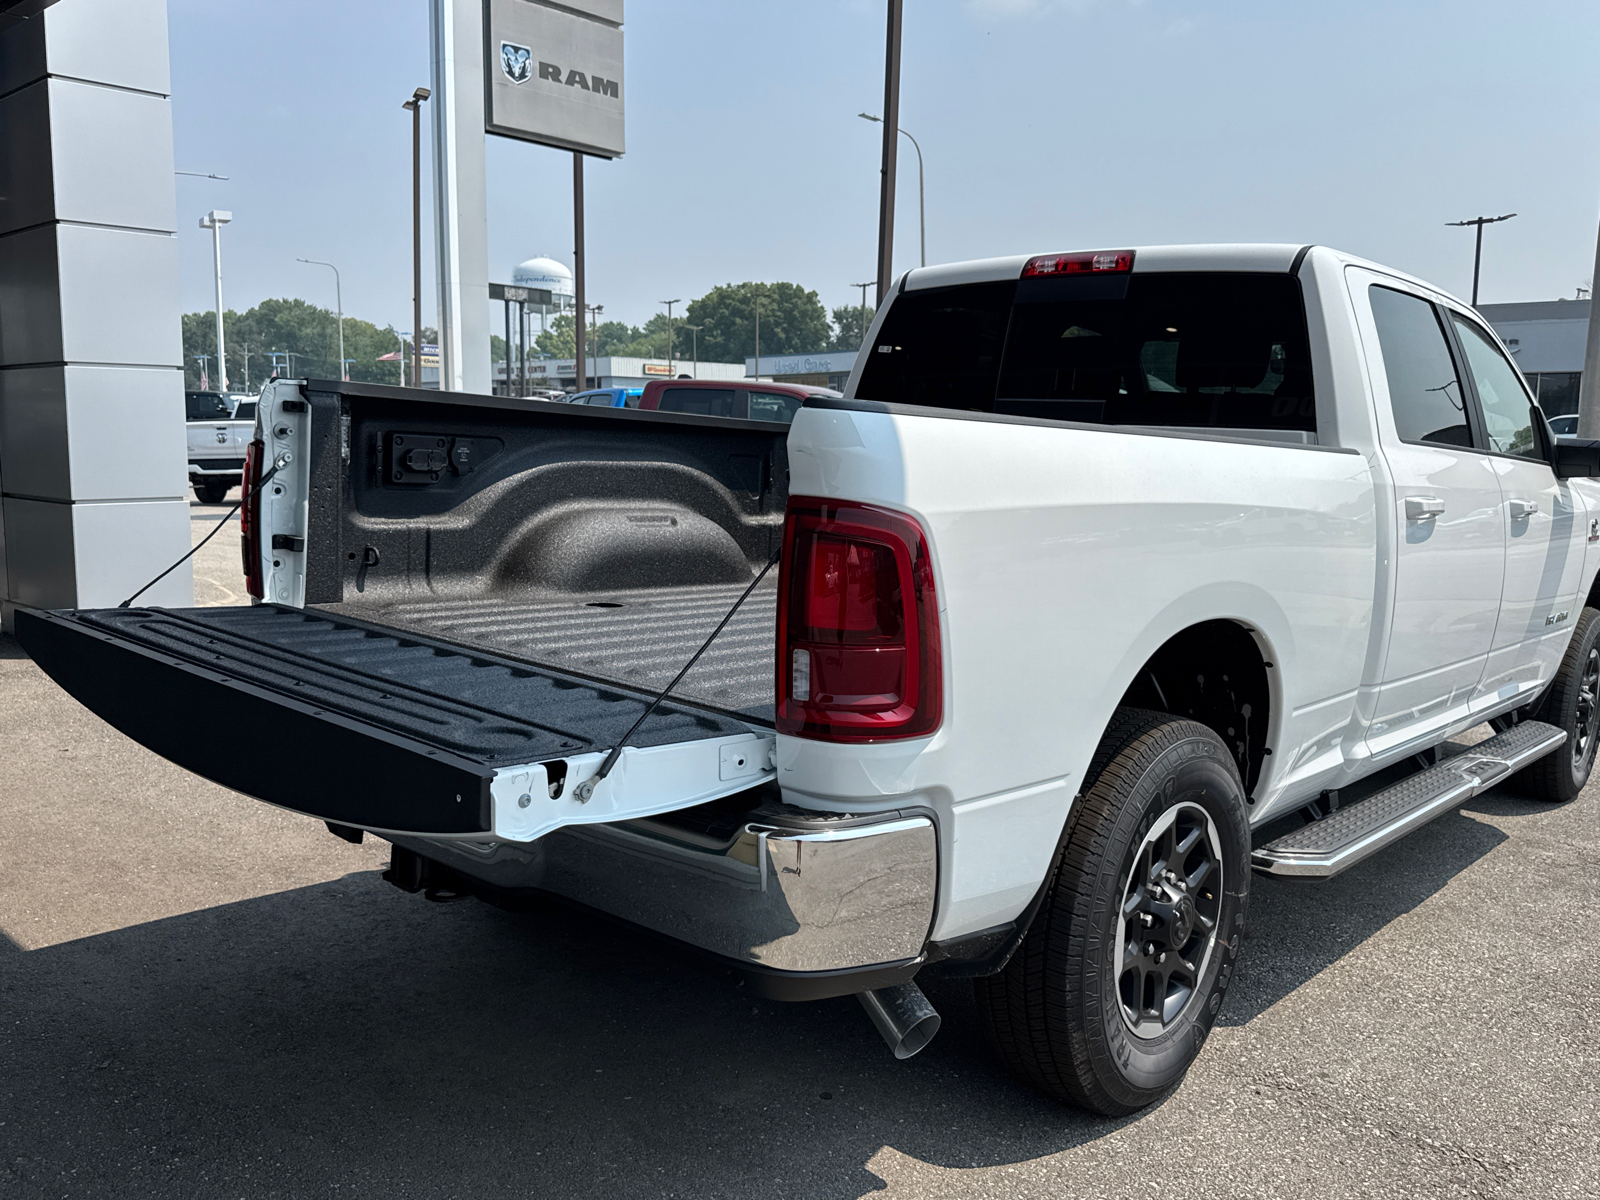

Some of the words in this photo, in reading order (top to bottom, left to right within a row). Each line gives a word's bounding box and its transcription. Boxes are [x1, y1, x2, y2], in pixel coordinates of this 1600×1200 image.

[538, 61, 619, 99] RAM
[774, 359, 800, 373] Used
[803, 358, 831, 372] Cars
